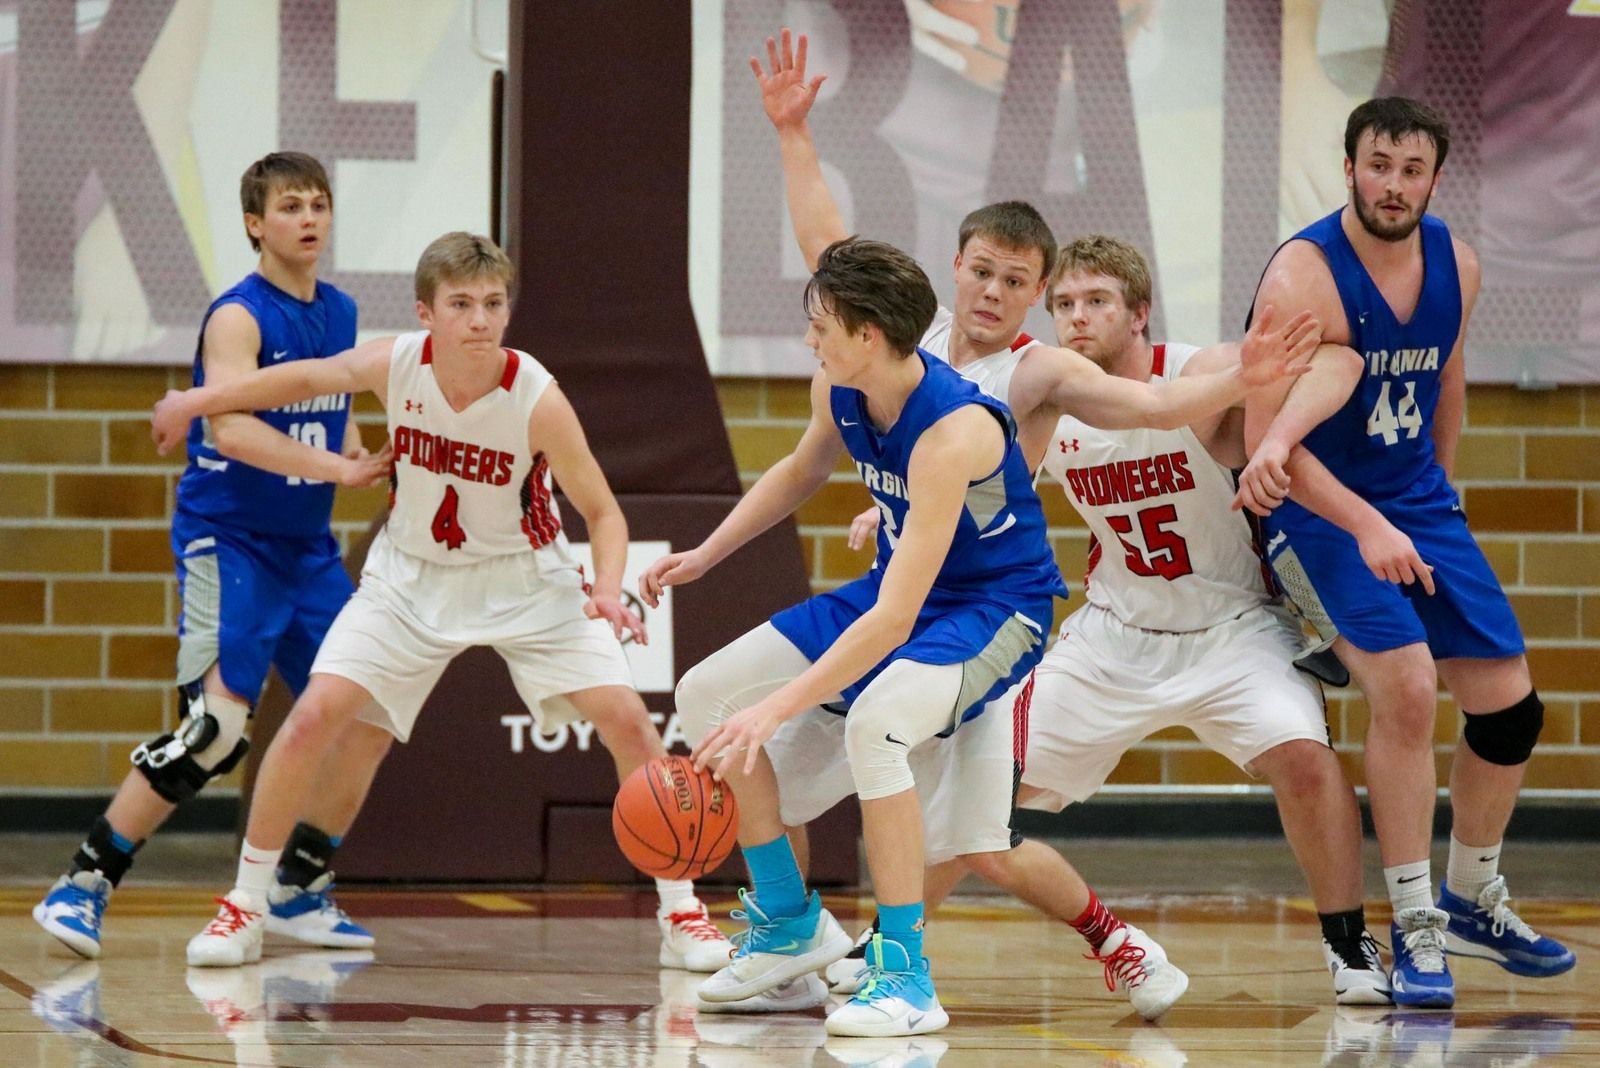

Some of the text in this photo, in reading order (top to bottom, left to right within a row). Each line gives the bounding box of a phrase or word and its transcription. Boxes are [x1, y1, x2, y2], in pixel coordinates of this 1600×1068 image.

[1366, 381, 1423, 446] 44
[394, 425, 515, 486] PIONEERS
[1066, 450, 1196, 507] PIONEERS
[431, 484, 467, 551] 4
[1105, 503, 1193, 581] 55
[501, 711, 692, 753] TOYA
